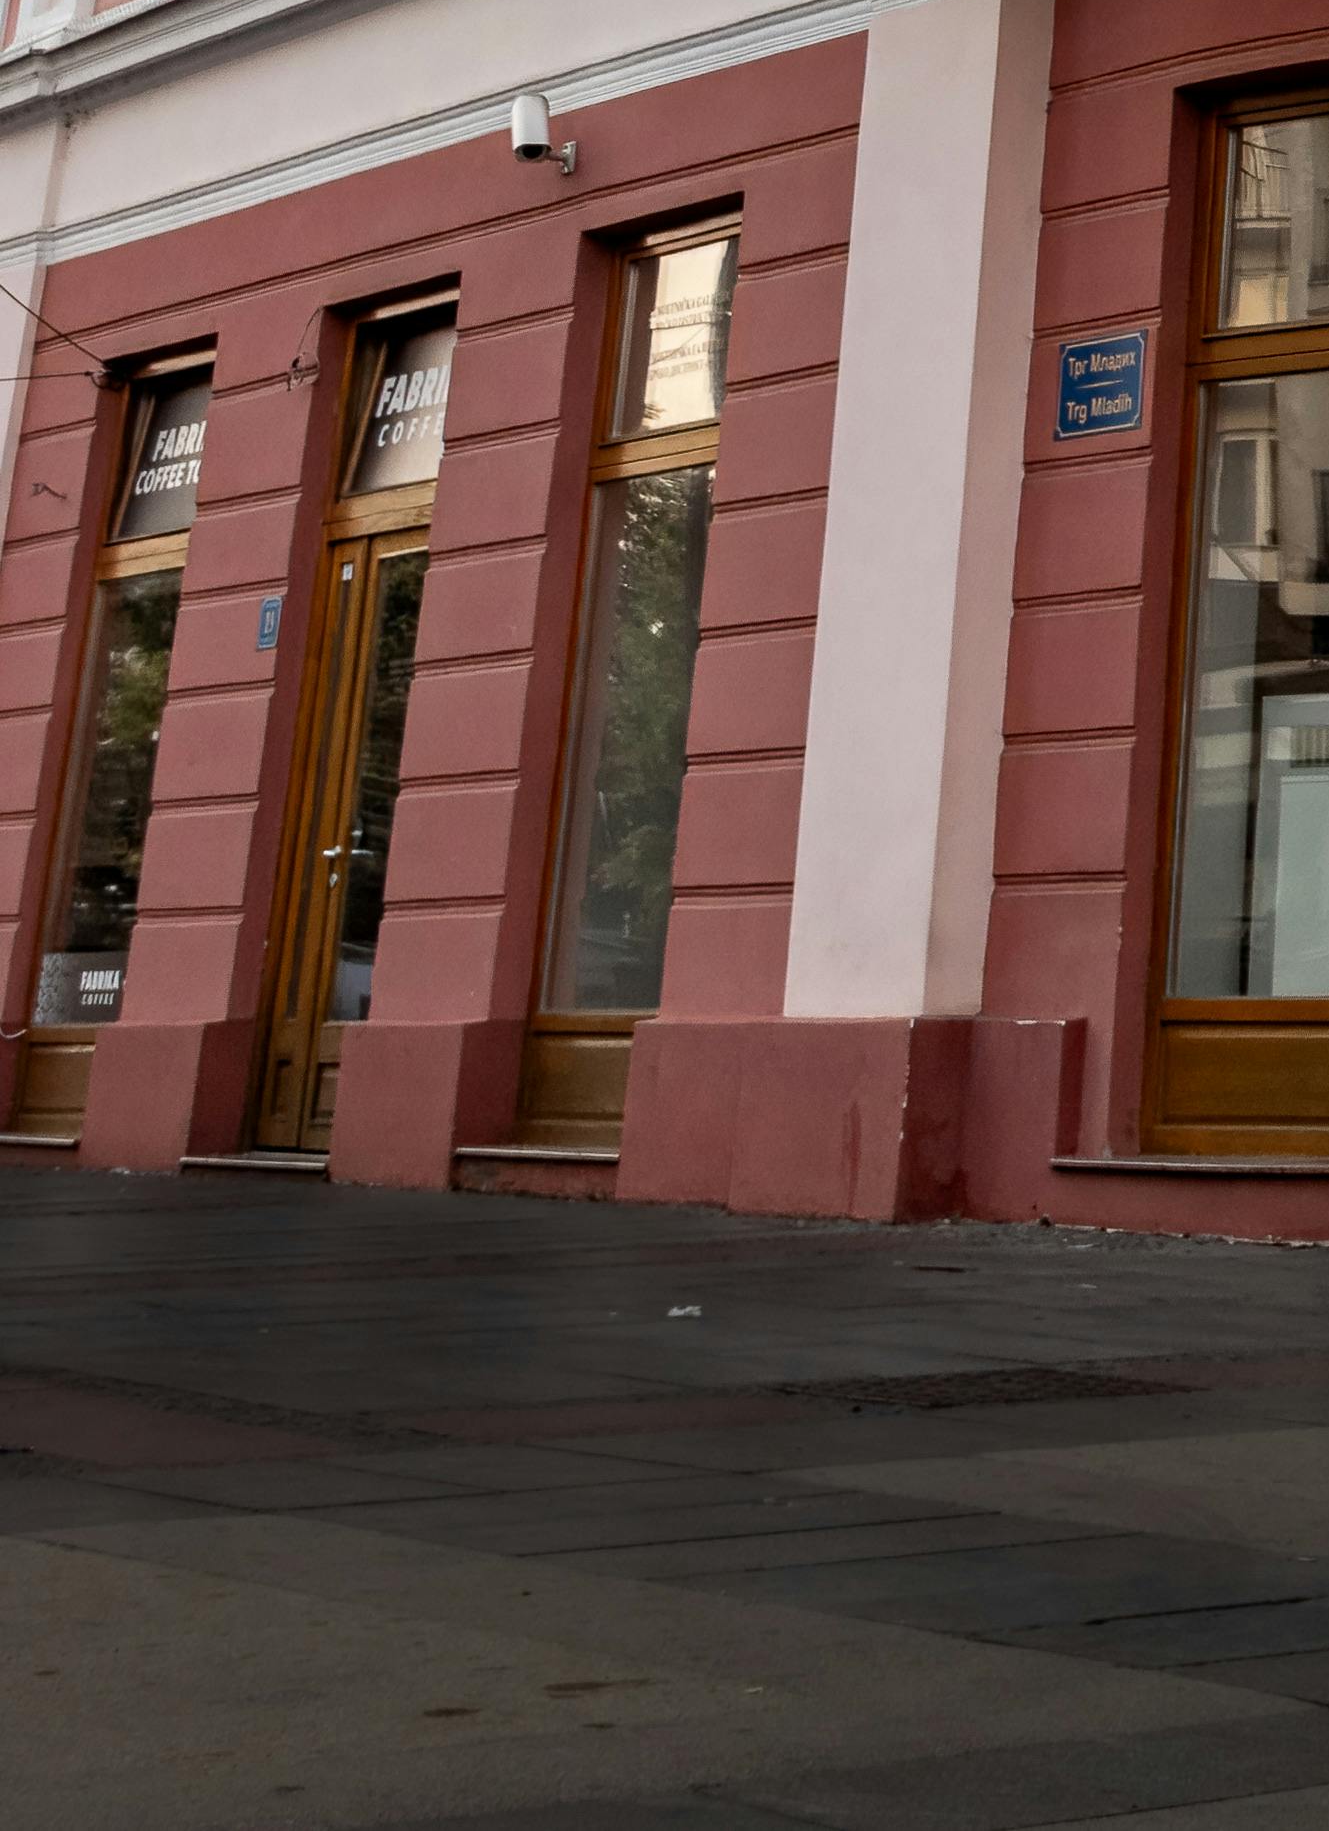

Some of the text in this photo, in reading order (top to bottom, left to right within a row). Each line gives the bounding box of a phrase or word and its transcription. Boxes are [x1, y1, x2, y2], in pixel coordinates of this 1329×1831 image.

[1068, 351, 1136, 380] Трг Младих
[1067, 393, 1132, 424] Trg Mladih
[152, 420, 207, 462] FABRI
[135, 461, 187, 496] COFFEE
[80, 970, 121, 992] FABRIKA
